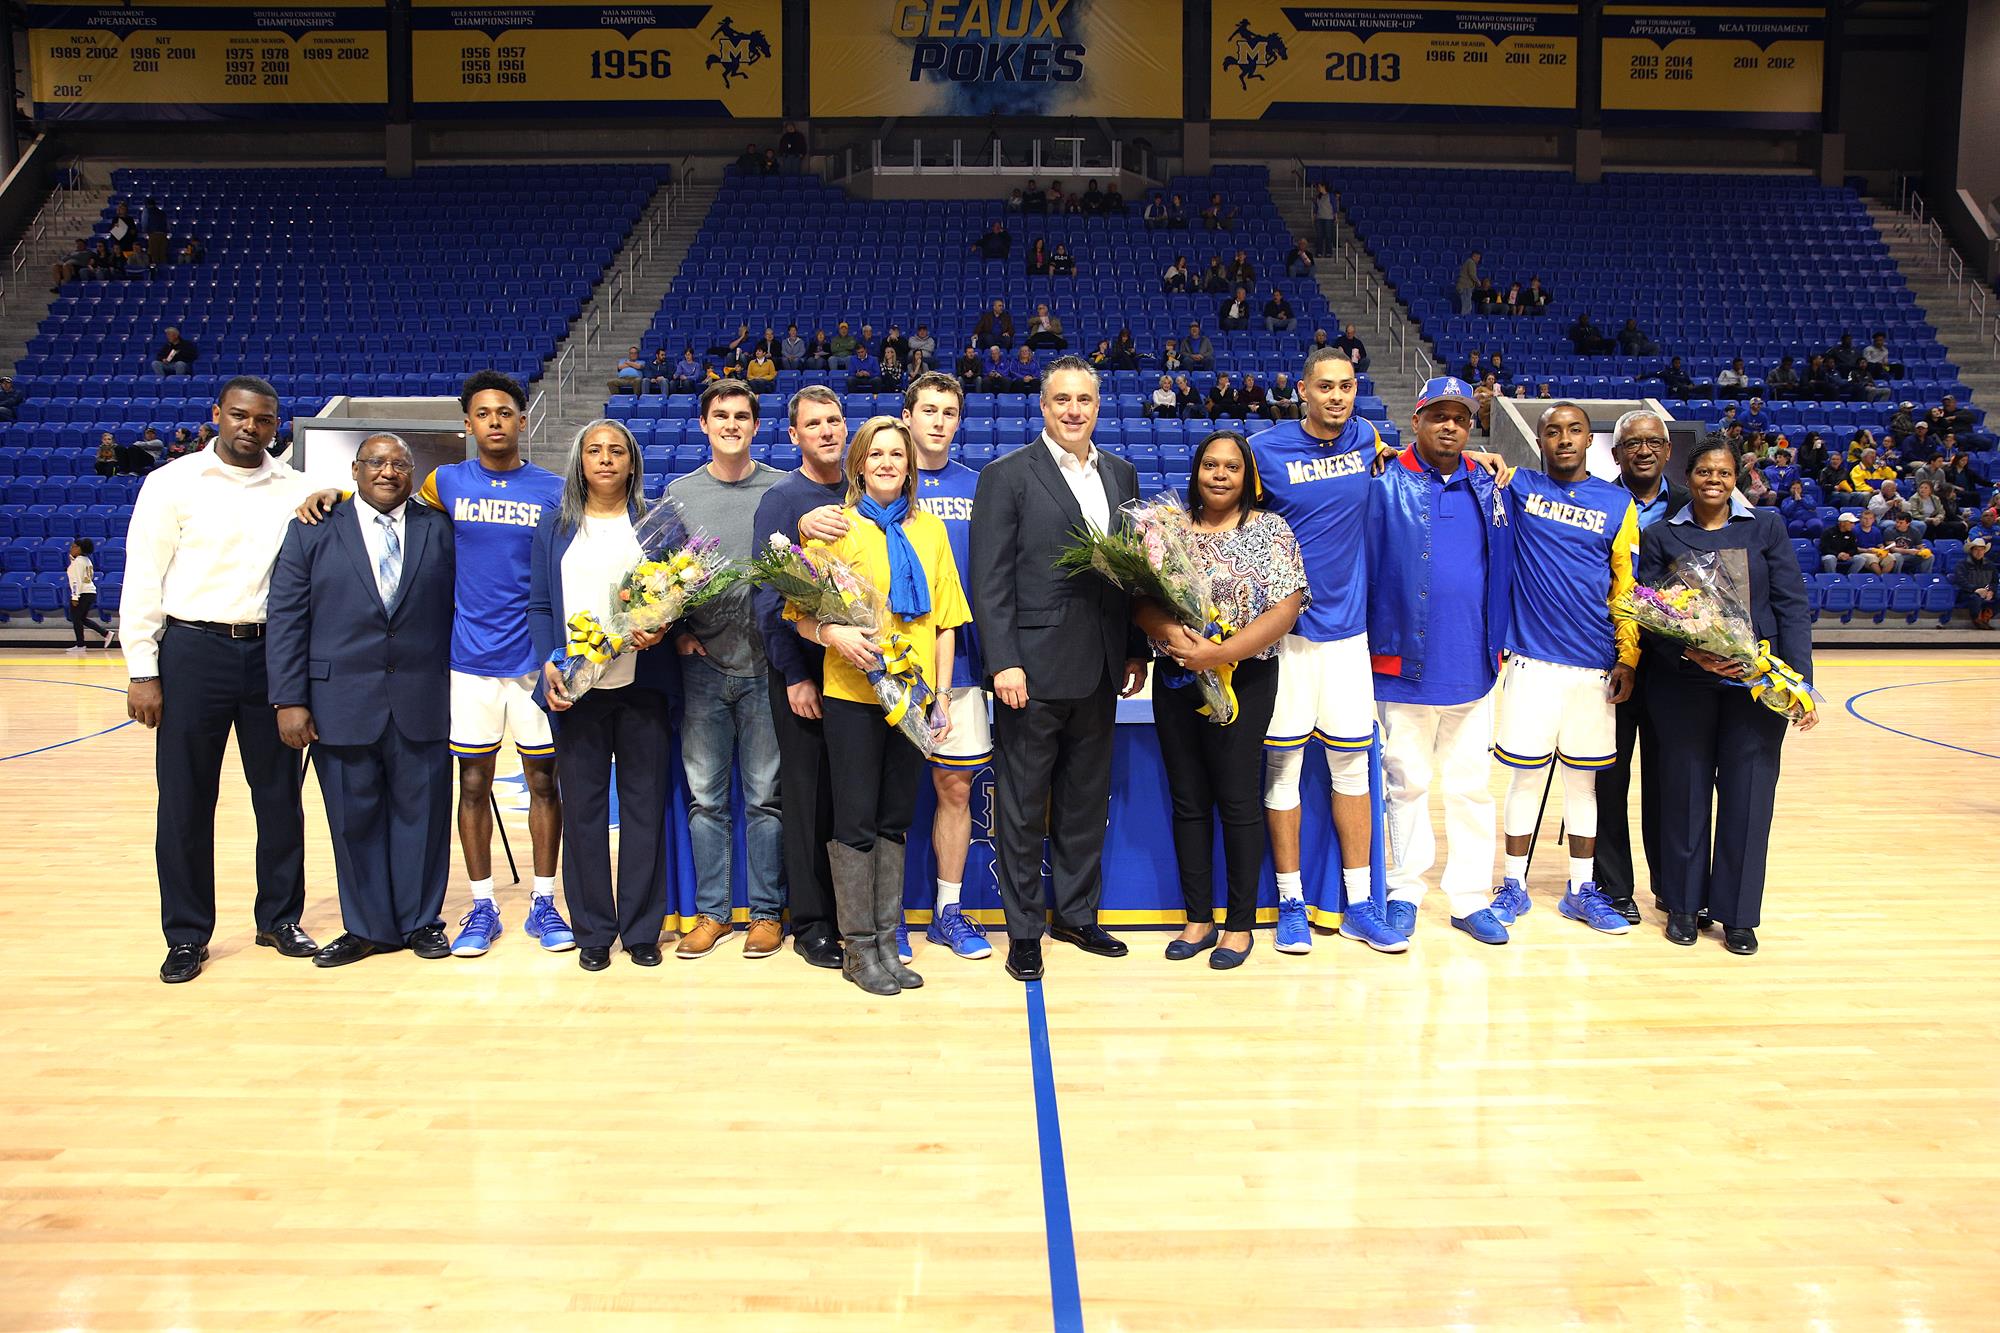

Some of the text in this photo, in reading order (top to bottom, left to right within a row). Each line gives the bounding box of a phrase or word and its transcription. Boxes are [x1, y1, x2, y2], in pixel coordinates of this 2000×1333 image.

[454, 17, 533, 25] CHAMPIONSHIPS
[891, 0, 1069, 38] GEAUX
[1312, 19, 1415, 28] NATIONAL RUNNER-UP
[1459, 22, 1535, 31] CHAMPIONSHIPS
[1629, 25, 1696, 35] APPEARANCES
[1718, 24, 1809, 33] NCAA TOURNAMENT
[71, 36, 96, 44] NCAA
[51, 48, 118, 58] 1989 2002
[130, 48, 196, 59] 1986 2001
[226, 48, 289, 59] 1975 1978
[304, 48, 369, 59] 1989 2002
[461, 47, 526, 58] 1956 1957
[1426, 51, 1488, 62] 1986 2011
[591, 50, 671, 78] 1956
[910, 42, 1087, 82] POKES
[1506, 52, 1567, 65] 2011 2012
[1631, 56, 1692, 67] 2013 2014
[1734, 57, 1795, 68] 2011 2012
[134, 61, 158, 72] 2011
[226, 61, 290, 72] 1997 2001
[462, 60, 524, 71] 1958 1961
[1325, 52, 1400, 82] 2013
[463, 73, 526, 84] 1963 1968
[1630, 68, 1693, 80] 2015 2016
[225, 75, 288, 85] 2002 2011
[54, 86, 82, 96] 2012
